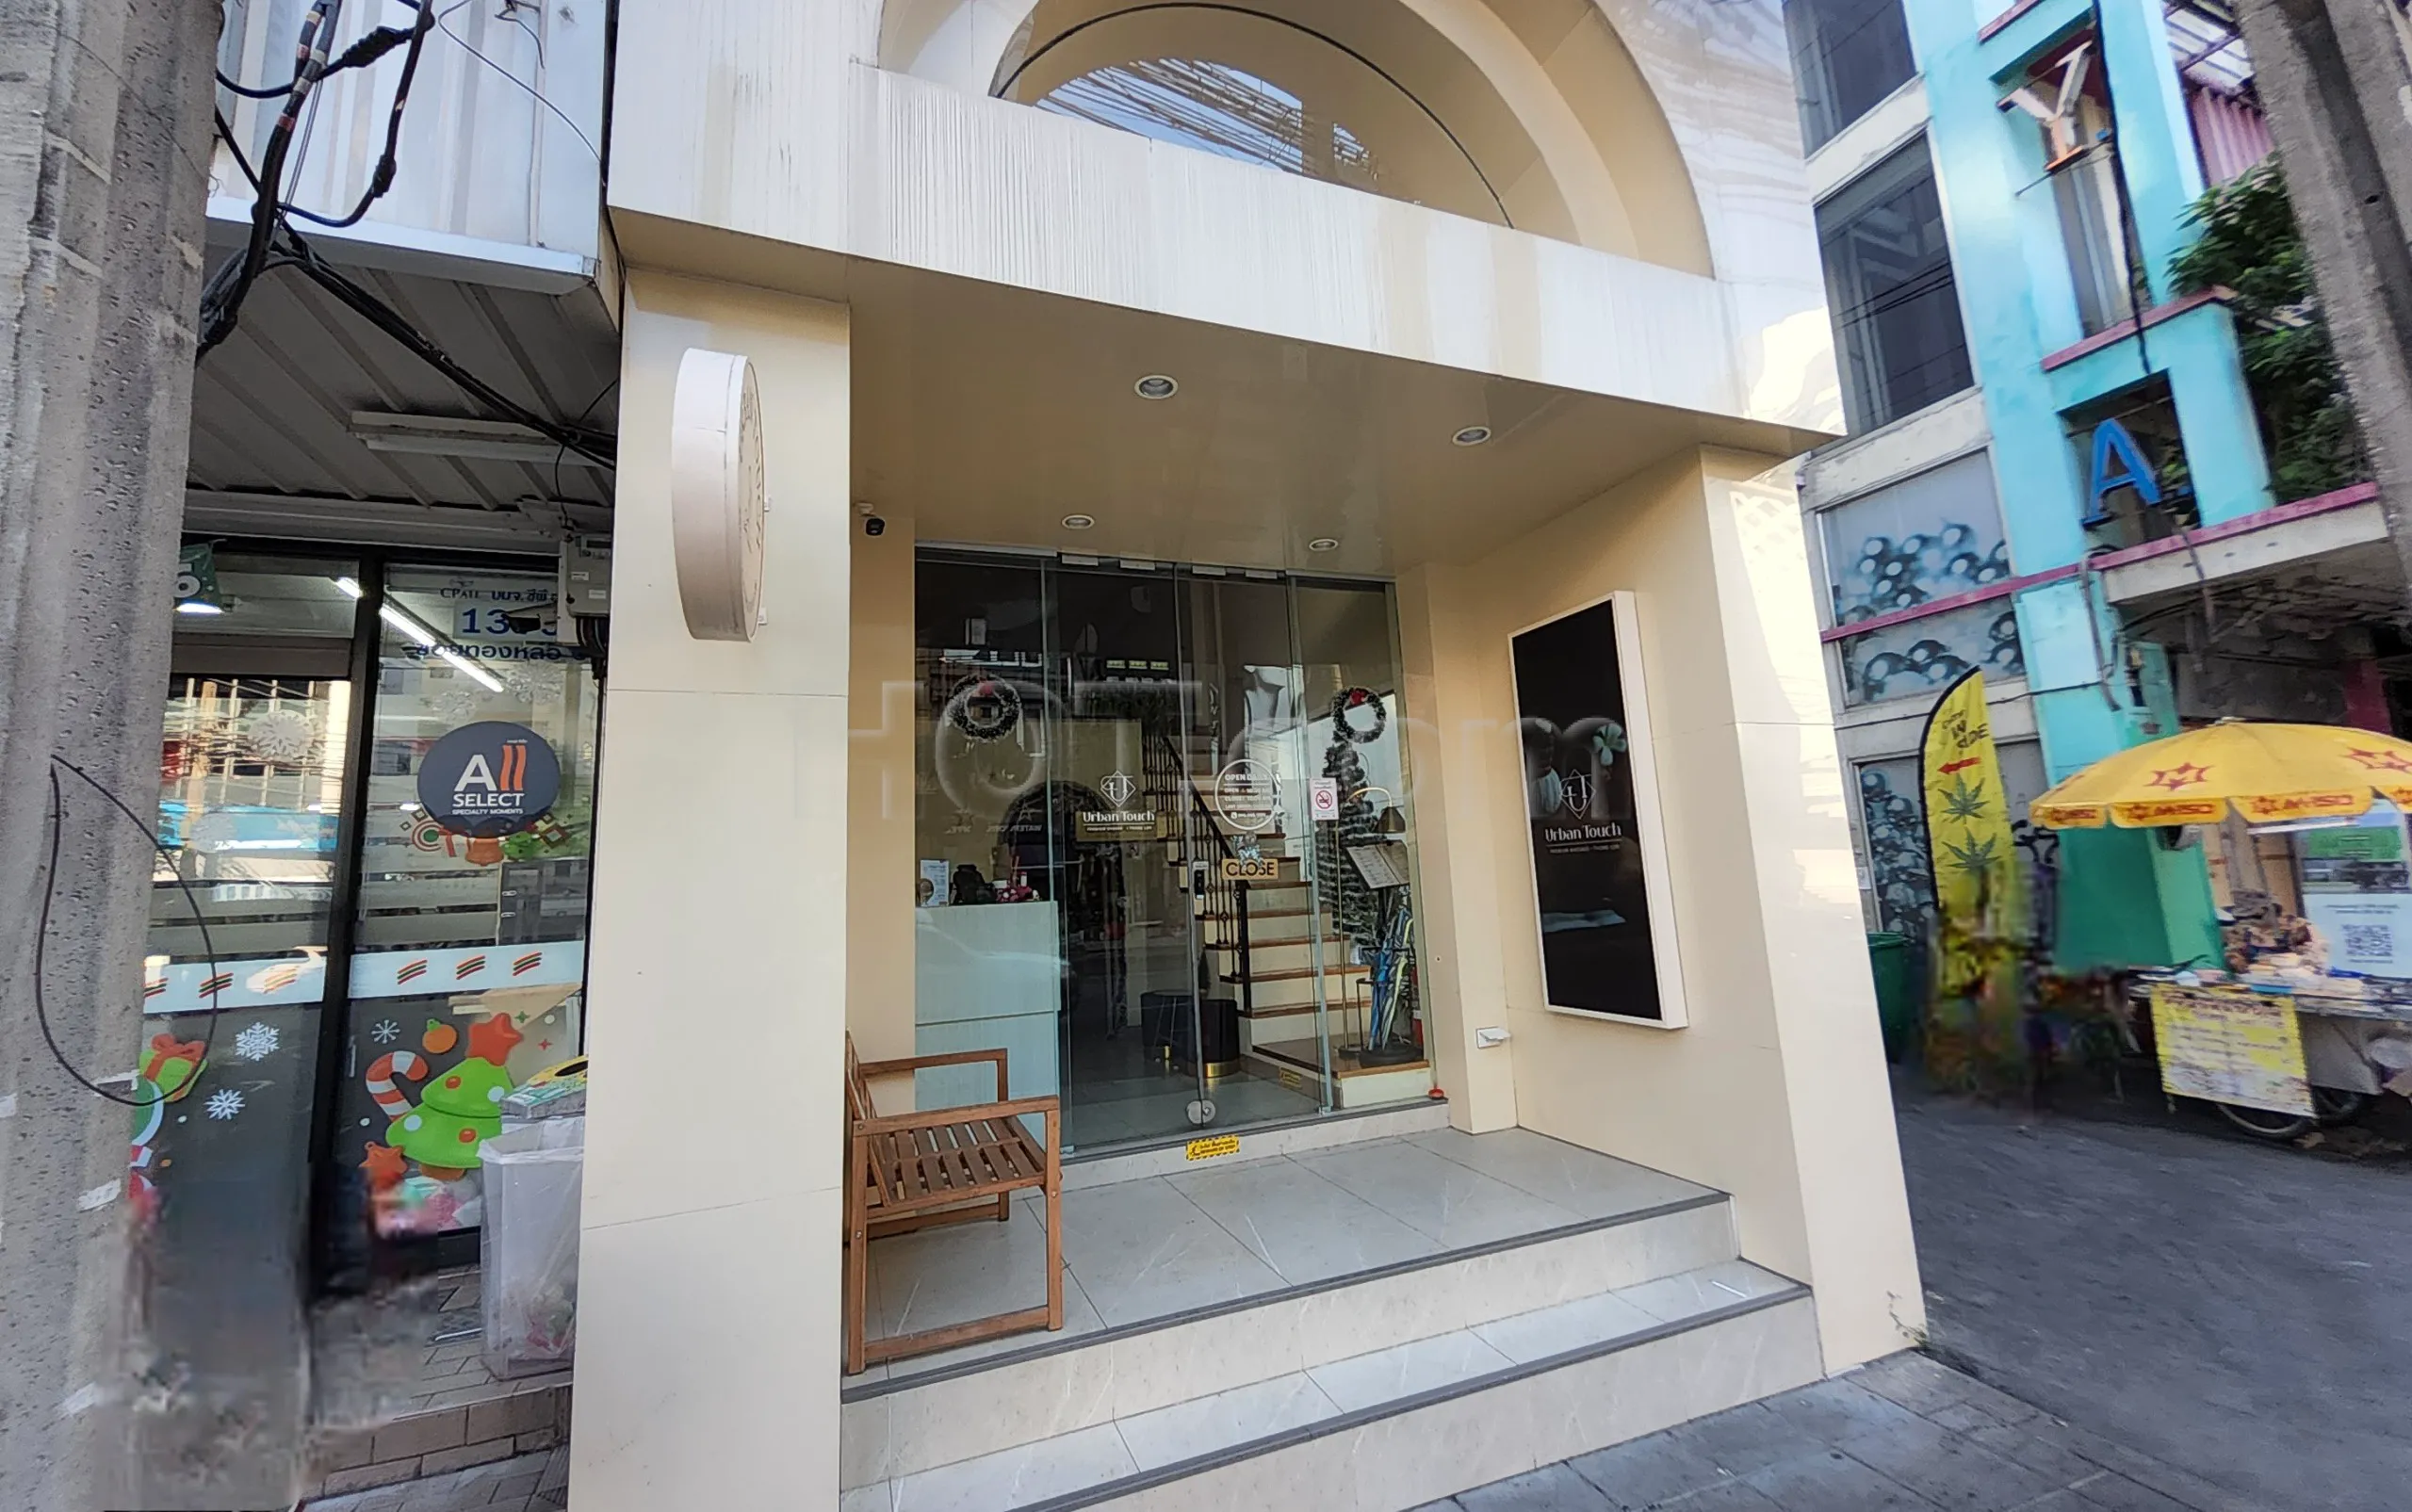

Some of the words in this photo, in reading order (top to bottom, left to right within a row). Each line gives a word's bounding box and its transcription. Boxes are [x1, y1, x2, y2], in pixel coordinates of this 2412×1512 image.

[2080, 417, 2192, 529] A
[462, 608, 558, 635] 13
[452, 792, 525, 807] SELECT
[1083, 811, 1119, 822] Urban
[1120, 810, 1155, 821] Touch
[1545, 828, 1582, 842] Urban
[1582, 821, 1622, 838] Touch
[1226, 861, 1275, 877] CLOSE
